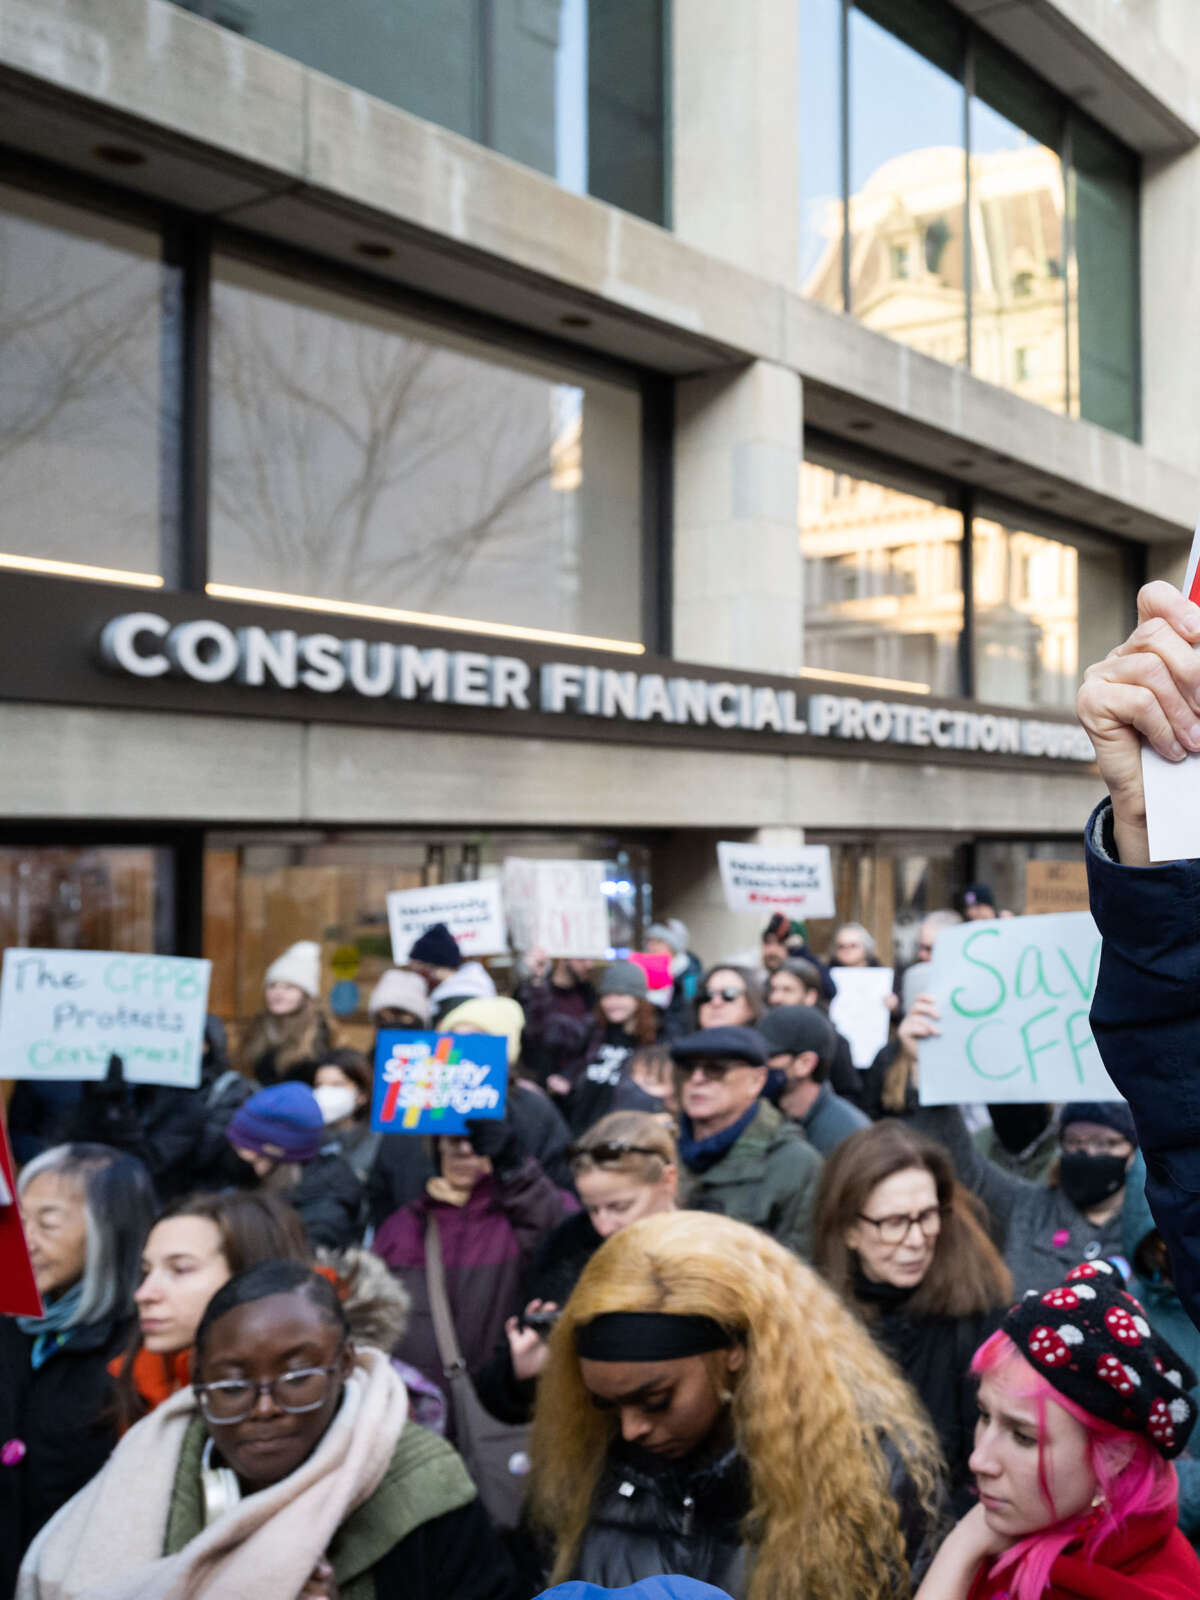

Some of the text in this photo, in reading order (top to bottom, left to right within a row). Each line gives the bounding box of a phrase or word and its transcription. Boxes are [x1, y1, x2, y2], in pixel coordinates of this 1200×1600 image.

[102, 612, 1096, 760] CONSUMER FINANCIAL PROTECTION BURE
[15, 957, 201, 1001] The CFPB
[951, 928, 1102, 1019] Sav
[52, 1001, 184, 1033] Protects
[965, 1005, 1095, 1085] CFP
